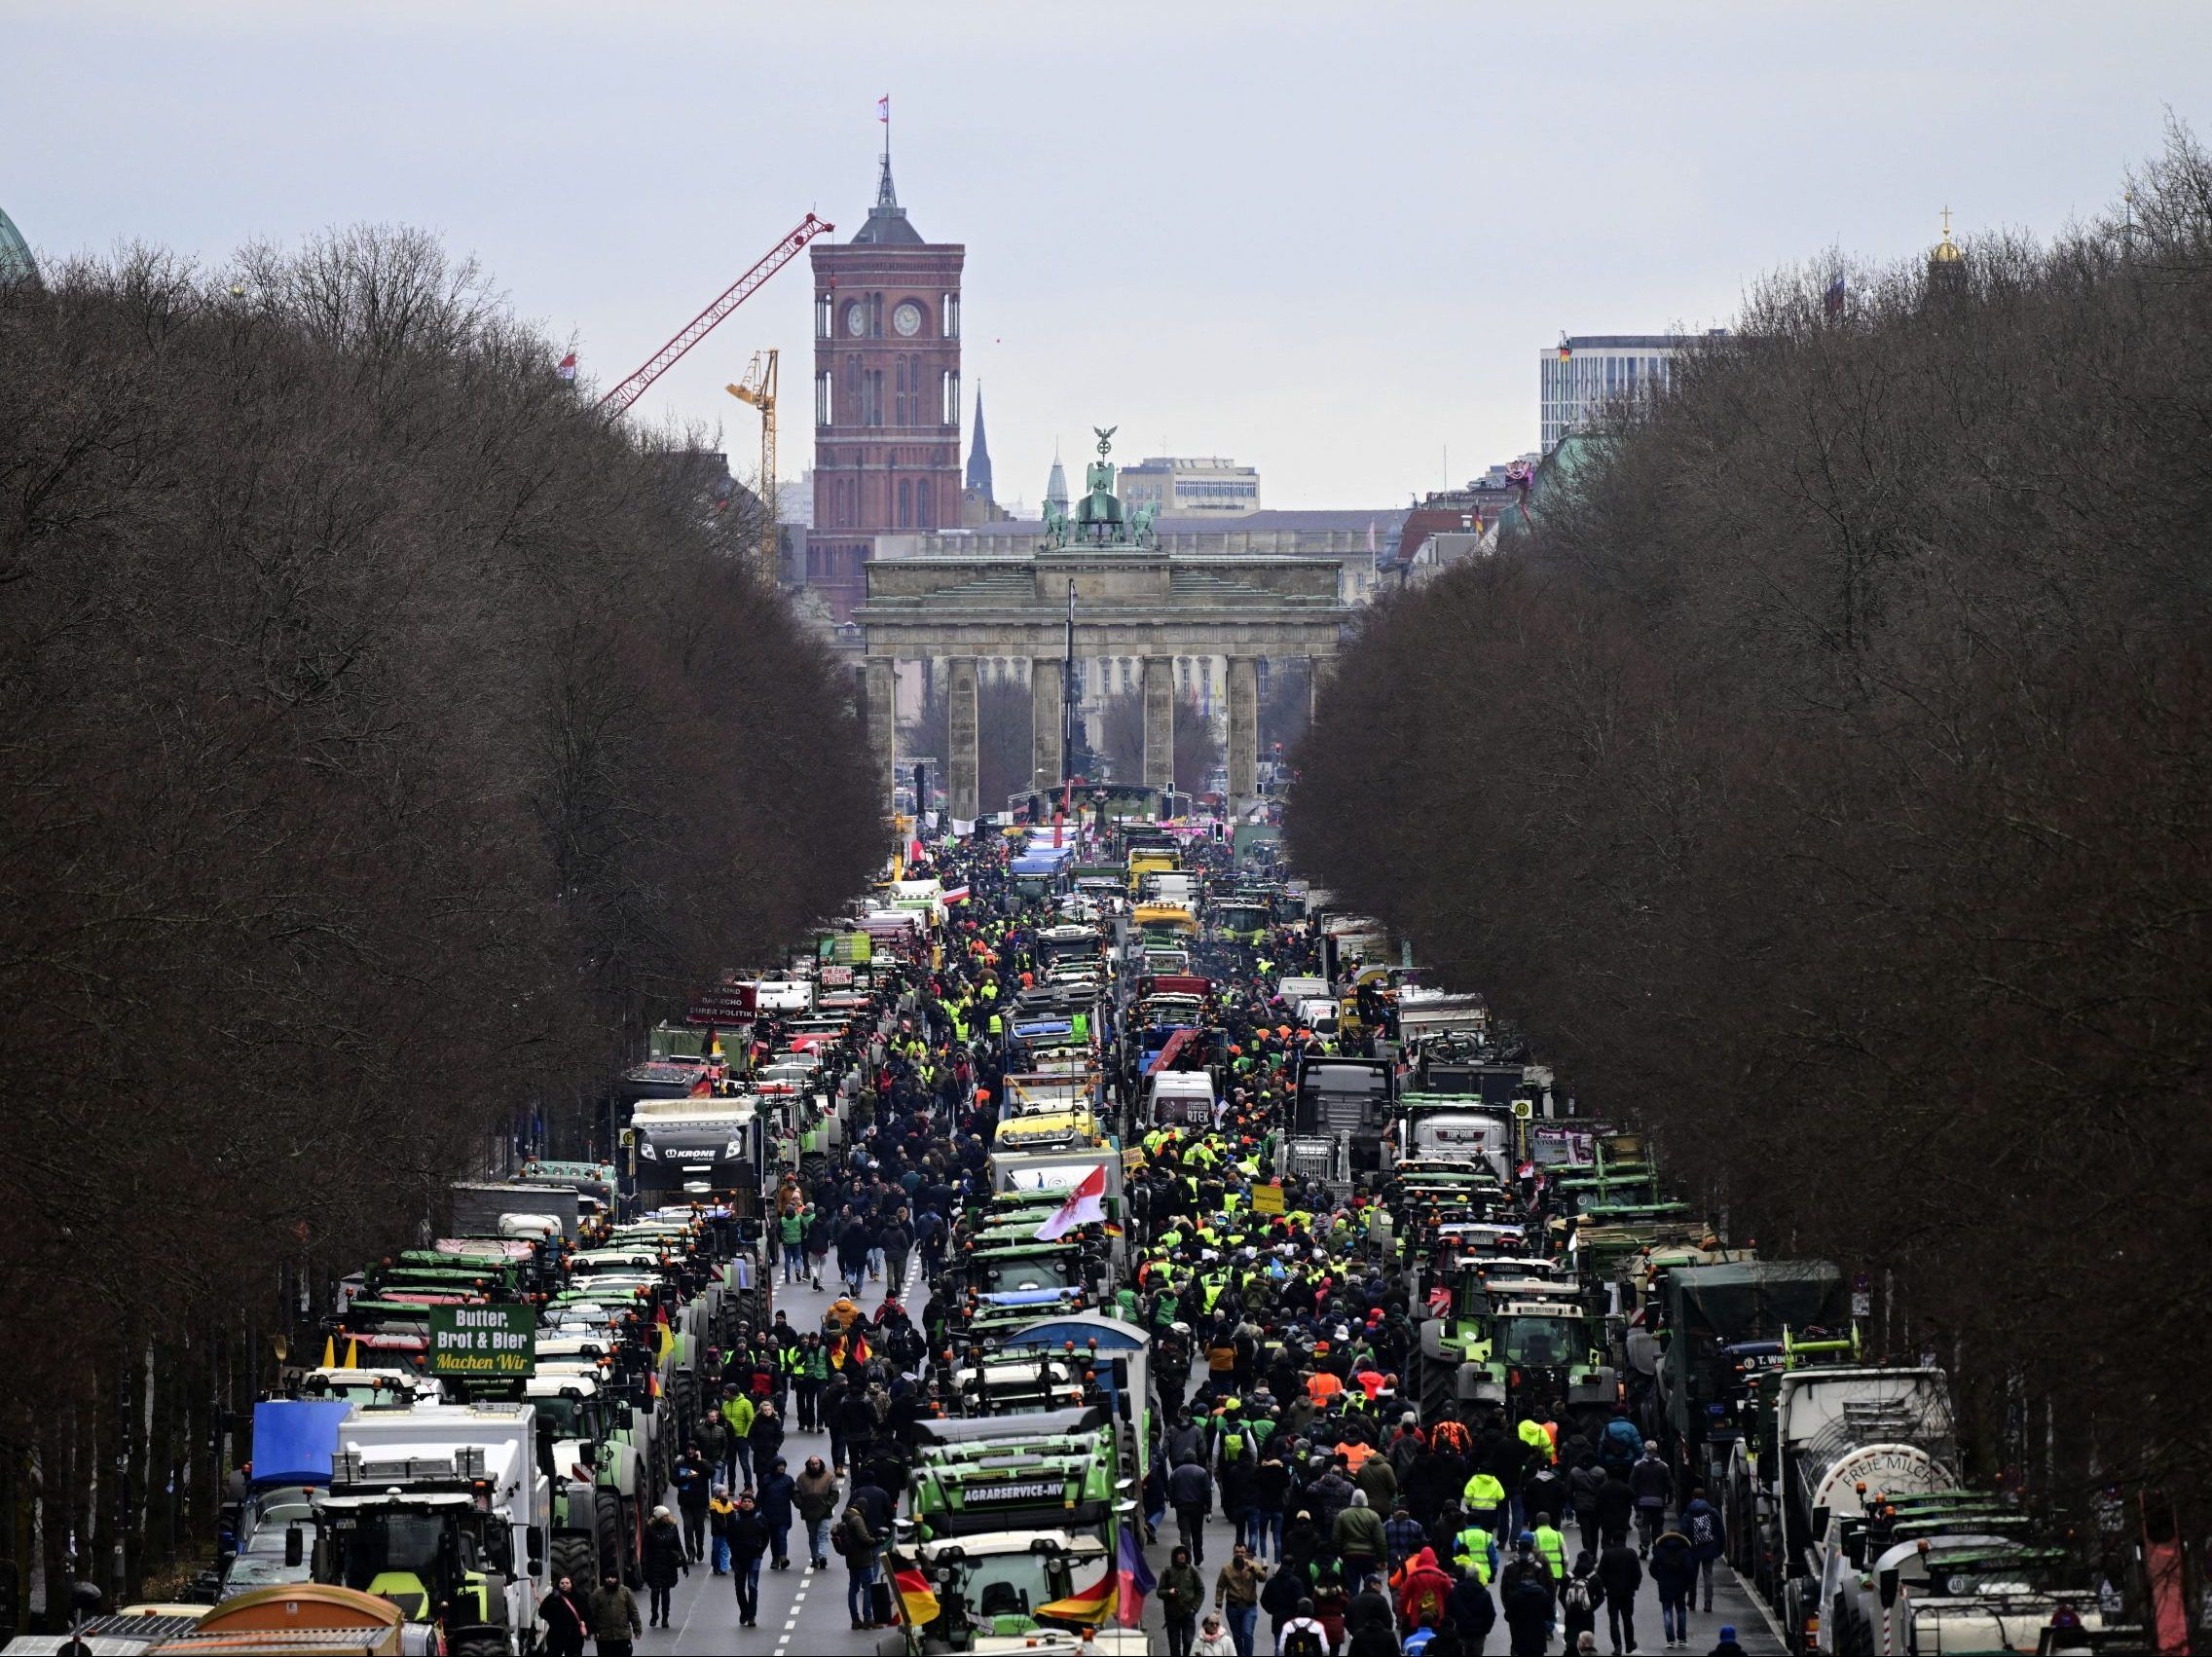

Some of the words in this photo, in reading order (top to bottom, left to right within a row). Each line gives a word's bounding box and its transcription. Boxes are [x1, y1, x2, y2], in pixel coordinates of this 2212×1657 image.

[719, 1009, 753, 1017] POLITIK
[456, 1309, 509, 1329] Butter,
[437, 1331, 473, 1349] Brot
[477, 1331, 488, 1349] &
[493, 1332, 528, 1349] Bier
[436, 1353, 494, 1370] Machen
[497, 1353, 528, 1370] Wir
[1757, 1355, 1766, 1365] T.
[1842, 1459, 1883, 1488] FREIE
[1887, 1456, 1932, 1484] MILCH
[964, 1483, 1064, 1502] AGRARSERVICE-MV
[1951, 1579, 1962, 1590] 40
